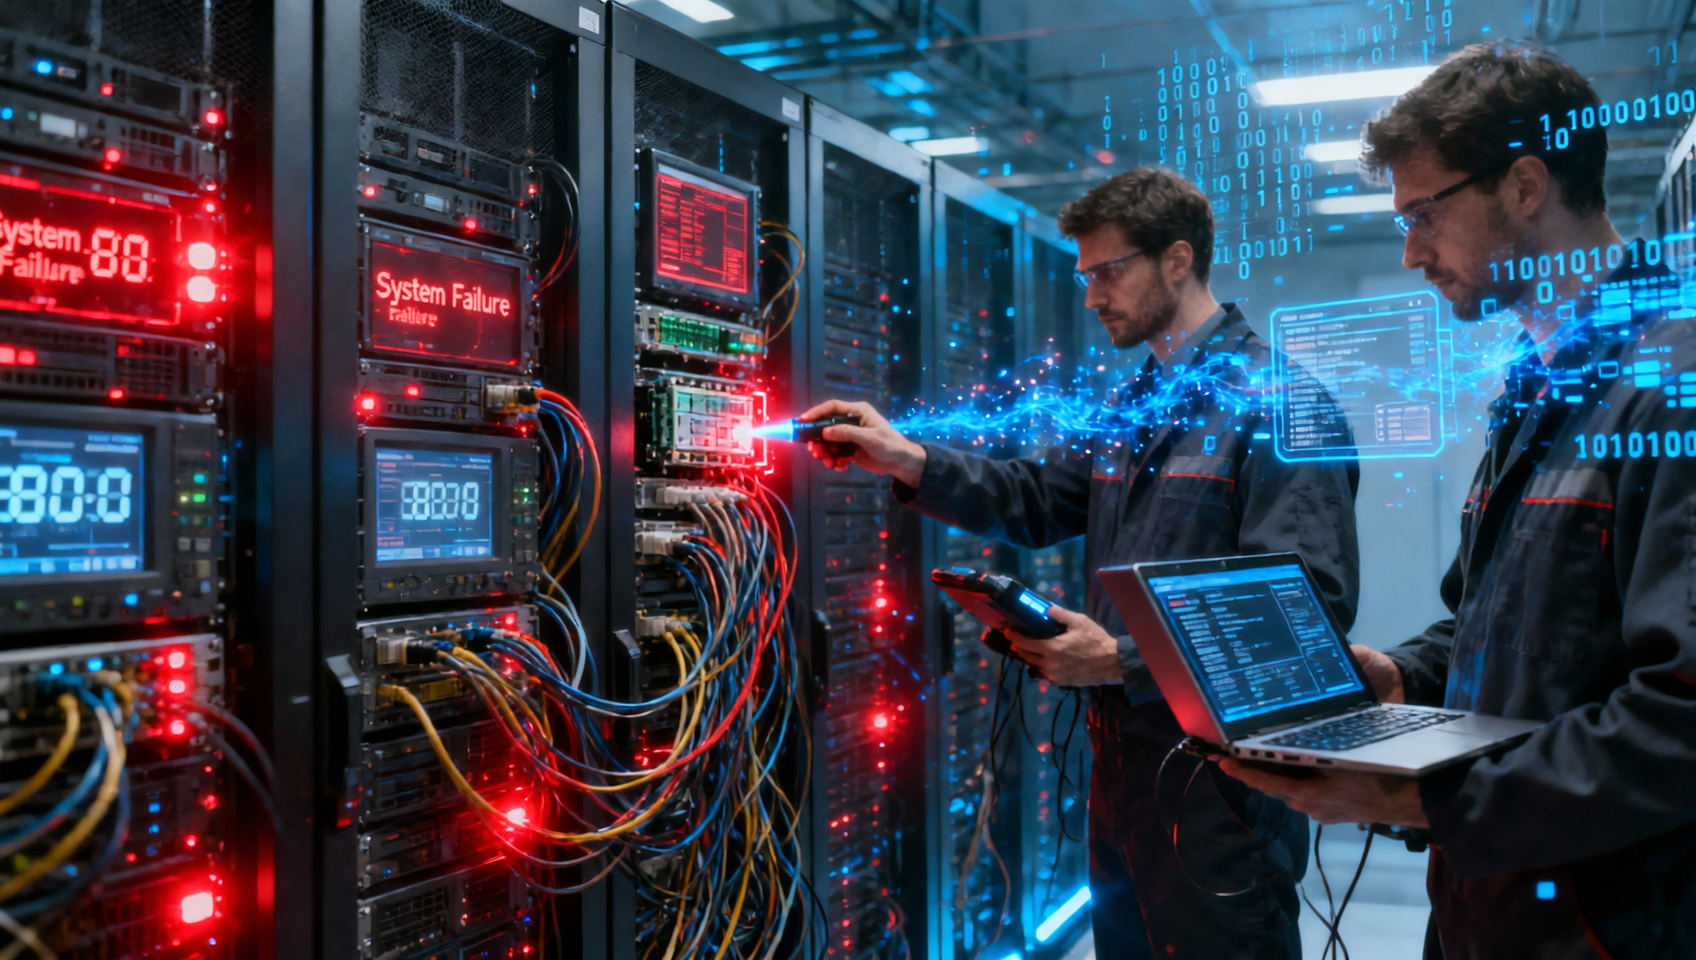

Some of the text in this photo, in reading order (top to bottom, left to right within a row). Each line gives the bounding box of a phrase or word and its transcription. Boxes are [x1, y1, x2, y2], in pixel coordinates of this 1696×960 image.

[0, 211, 81, 253] ystem
[376, 271, 510, 317] System Failure
